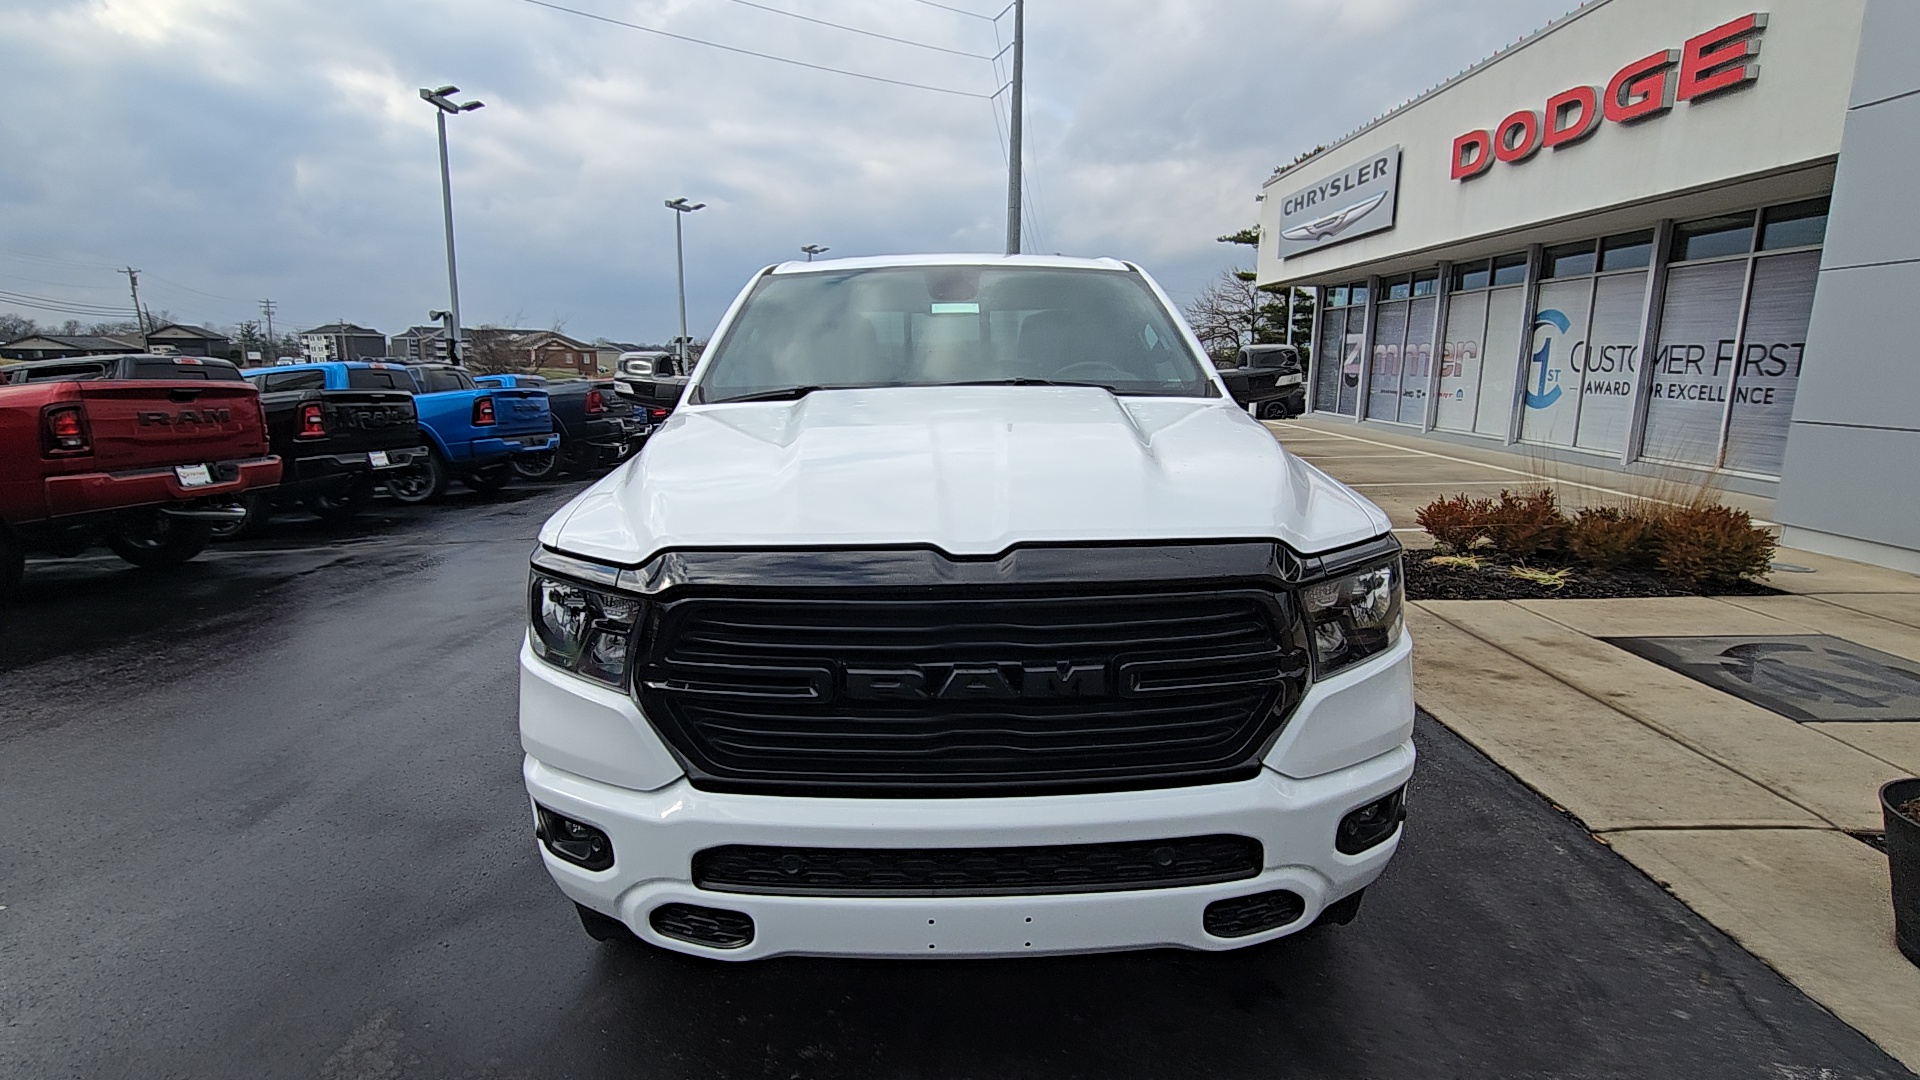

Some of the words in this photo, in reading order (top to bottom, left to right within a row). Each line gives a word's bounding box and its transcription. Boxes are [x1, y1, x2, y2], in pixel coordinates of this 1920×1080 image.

[1451, 13, 1768, 181] DODGE
[1284, 157, 1389, 217] CHRYSLER
[1343, 333, 1477, 378] Zmmer
[1570, 340, 1703, 375] CUSTMER
[1584, 381, 1631, 397] AWARD
[1667, 383, 1775, 405] EXCELLNCE
[137, 408, 230, 426] RAM
[846, 661, 1104, 698] RAM
